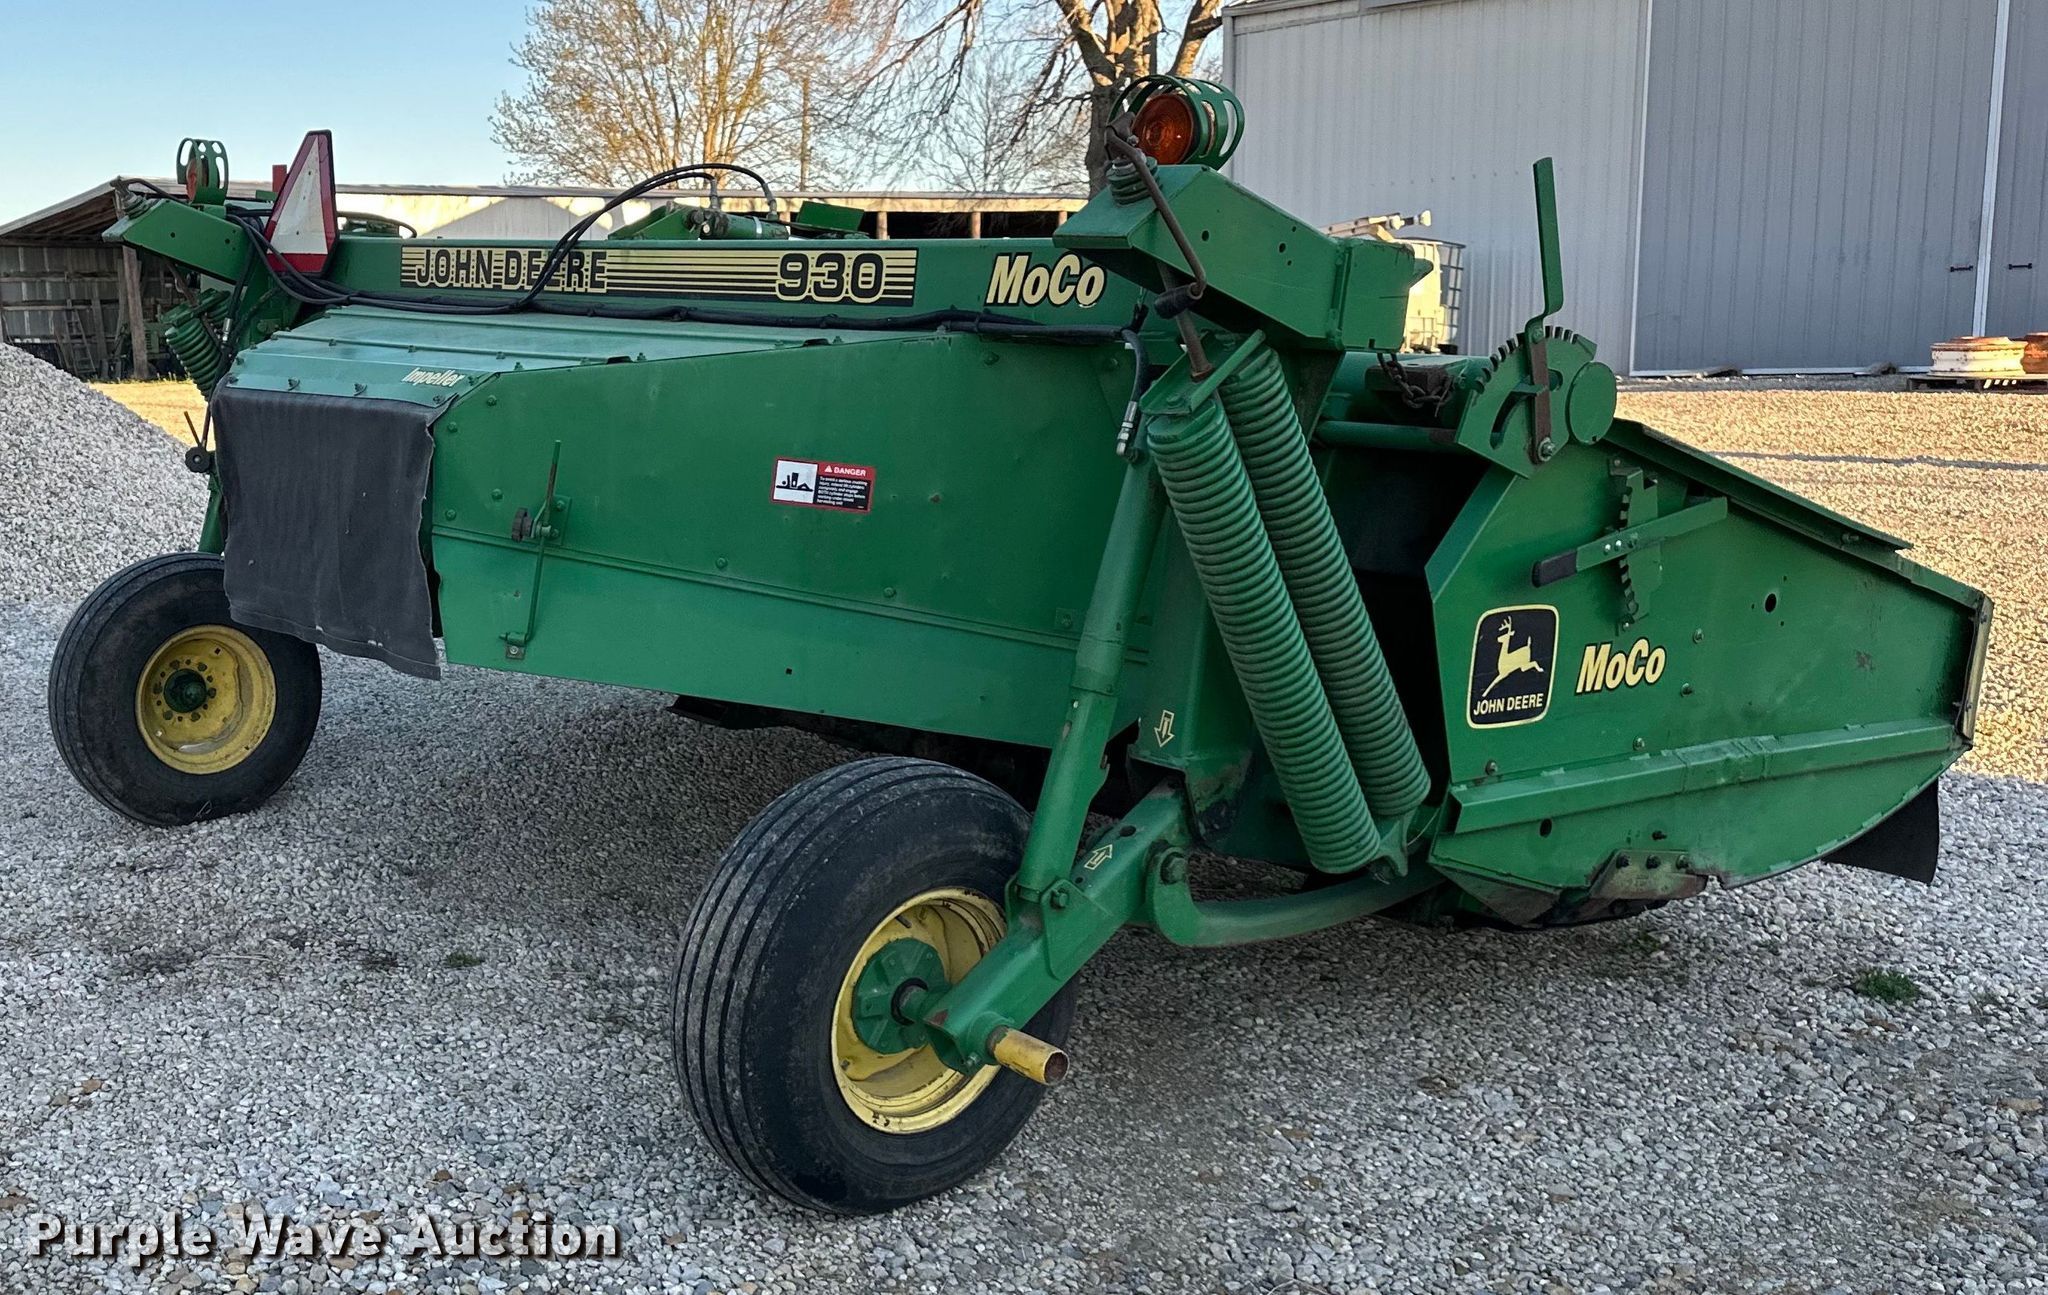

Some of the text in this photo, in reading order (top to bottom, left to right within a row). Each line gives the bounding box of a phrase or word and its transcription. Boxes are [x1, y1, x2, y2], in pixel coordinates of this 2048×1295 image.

[416, 248, 494, 287] JOHN
[776, 252, 884, 302] 930
[985, 252, 1106, 306] MoCo
[401, 366, 466, 387] Impeller
[833, 466, 867, 476] DANGER
[1575, 637, 1667, 696] MoCo
[1473, 693, 1544, 716] JOHN DEERE
